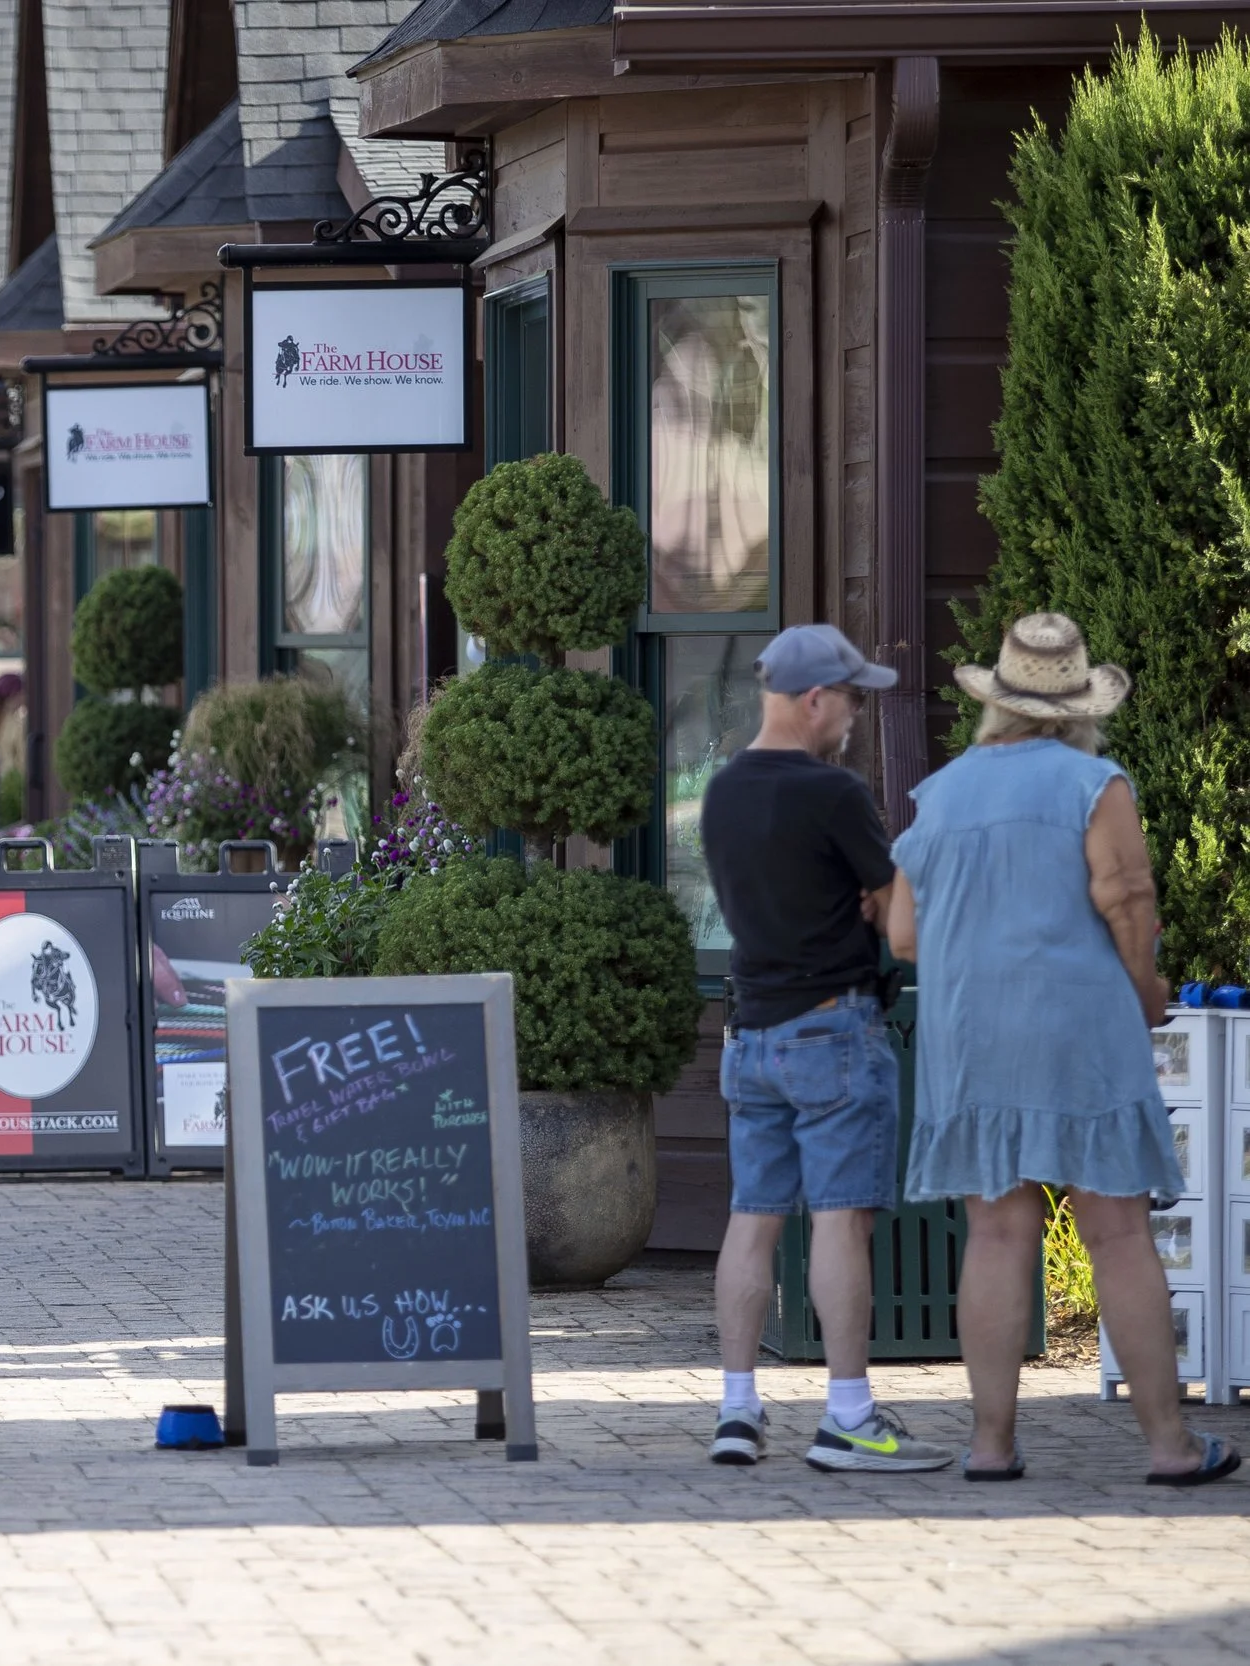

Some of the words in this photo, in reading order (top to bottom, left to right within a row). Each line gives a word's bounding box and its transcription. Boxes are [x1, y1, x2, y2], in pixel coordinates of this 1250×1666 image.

[314, 343, 337, 353] The
[301, 352, 361, 371] FARM
[366, 350, 444, 371] HOUSE
[300, 376, 317, 386] We
[319, 375, 342, 386] ride.
[345, 375, 362, 386] We
[364, 375, 392, 385] show.
[395, 374, 412, 385] We
[414, 373, 444, 385] know.
[161, 909, 215, 921] EQUILINE
[271, 1013, 427, 1104] FREE!
[266, 1099, 326, 1134] TRAVEL
[328, 1071, 393, 1106] WATER
[393, 1048, 457, 1077] BOWL
[370, 1143, 468, 1175] REALLY
[469, 1207, 491, 1227] NC
[281, 1294, 335, 1321] ASK
[342, 1294, 380, 1320] US
